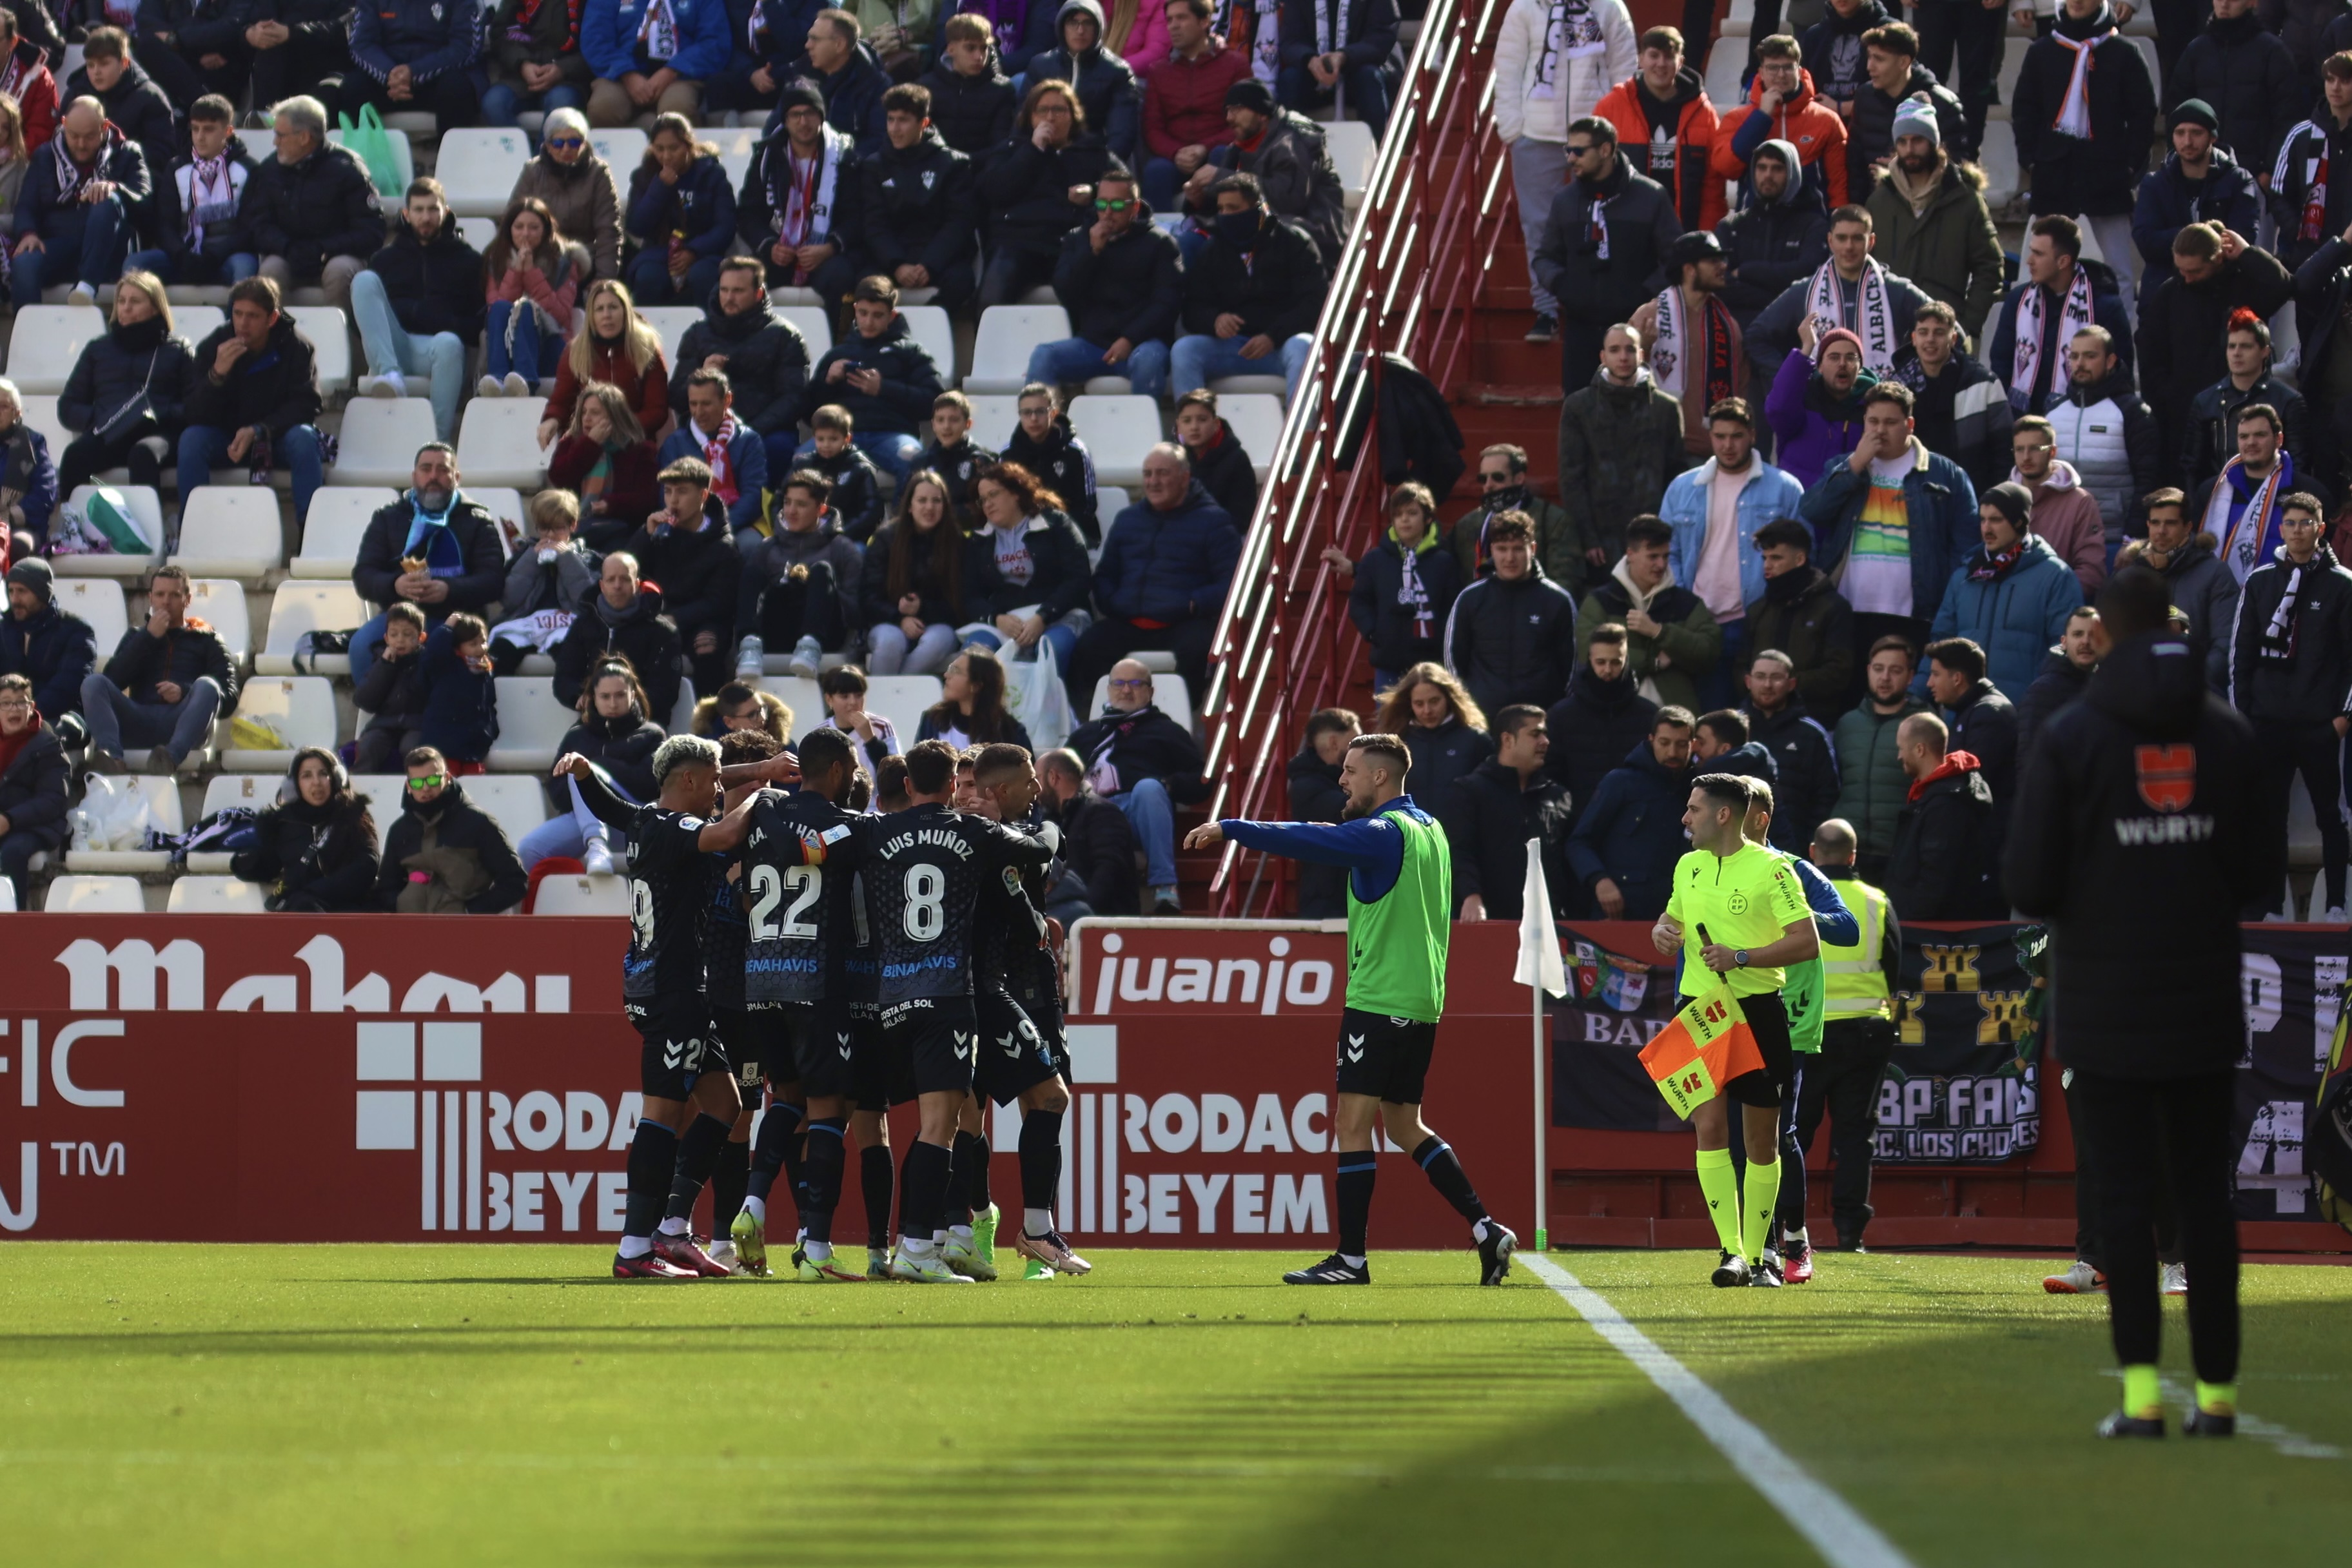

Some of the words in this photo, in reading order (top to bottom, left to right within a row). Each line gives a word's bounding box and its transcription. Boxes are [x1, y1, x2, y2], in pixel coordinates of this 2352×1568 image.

[879, 832, 914, 860] LUIS
[918, 829, 974, 861] MUÑOZ
[749, 865, 822, 943] 22
[903, 863, 945, 942] 8
[1779, 881, 1796, 910] WÜRTH
[1094, 933, 1334, 1014] juanjo
[914, 999, 934, 1008] SOL
[1689, 1006, 1712, 1040] WÜRTH
[1667, 1077, 1689, 1110] WÜRTH
[1877, 1079, 1932, 1126] BP
[1948, 1067, 2037, 1126] FANS
[1908, 1133, 1954, 1157] LOS
[1124, 1174, 1329, 1233] BEYEM
